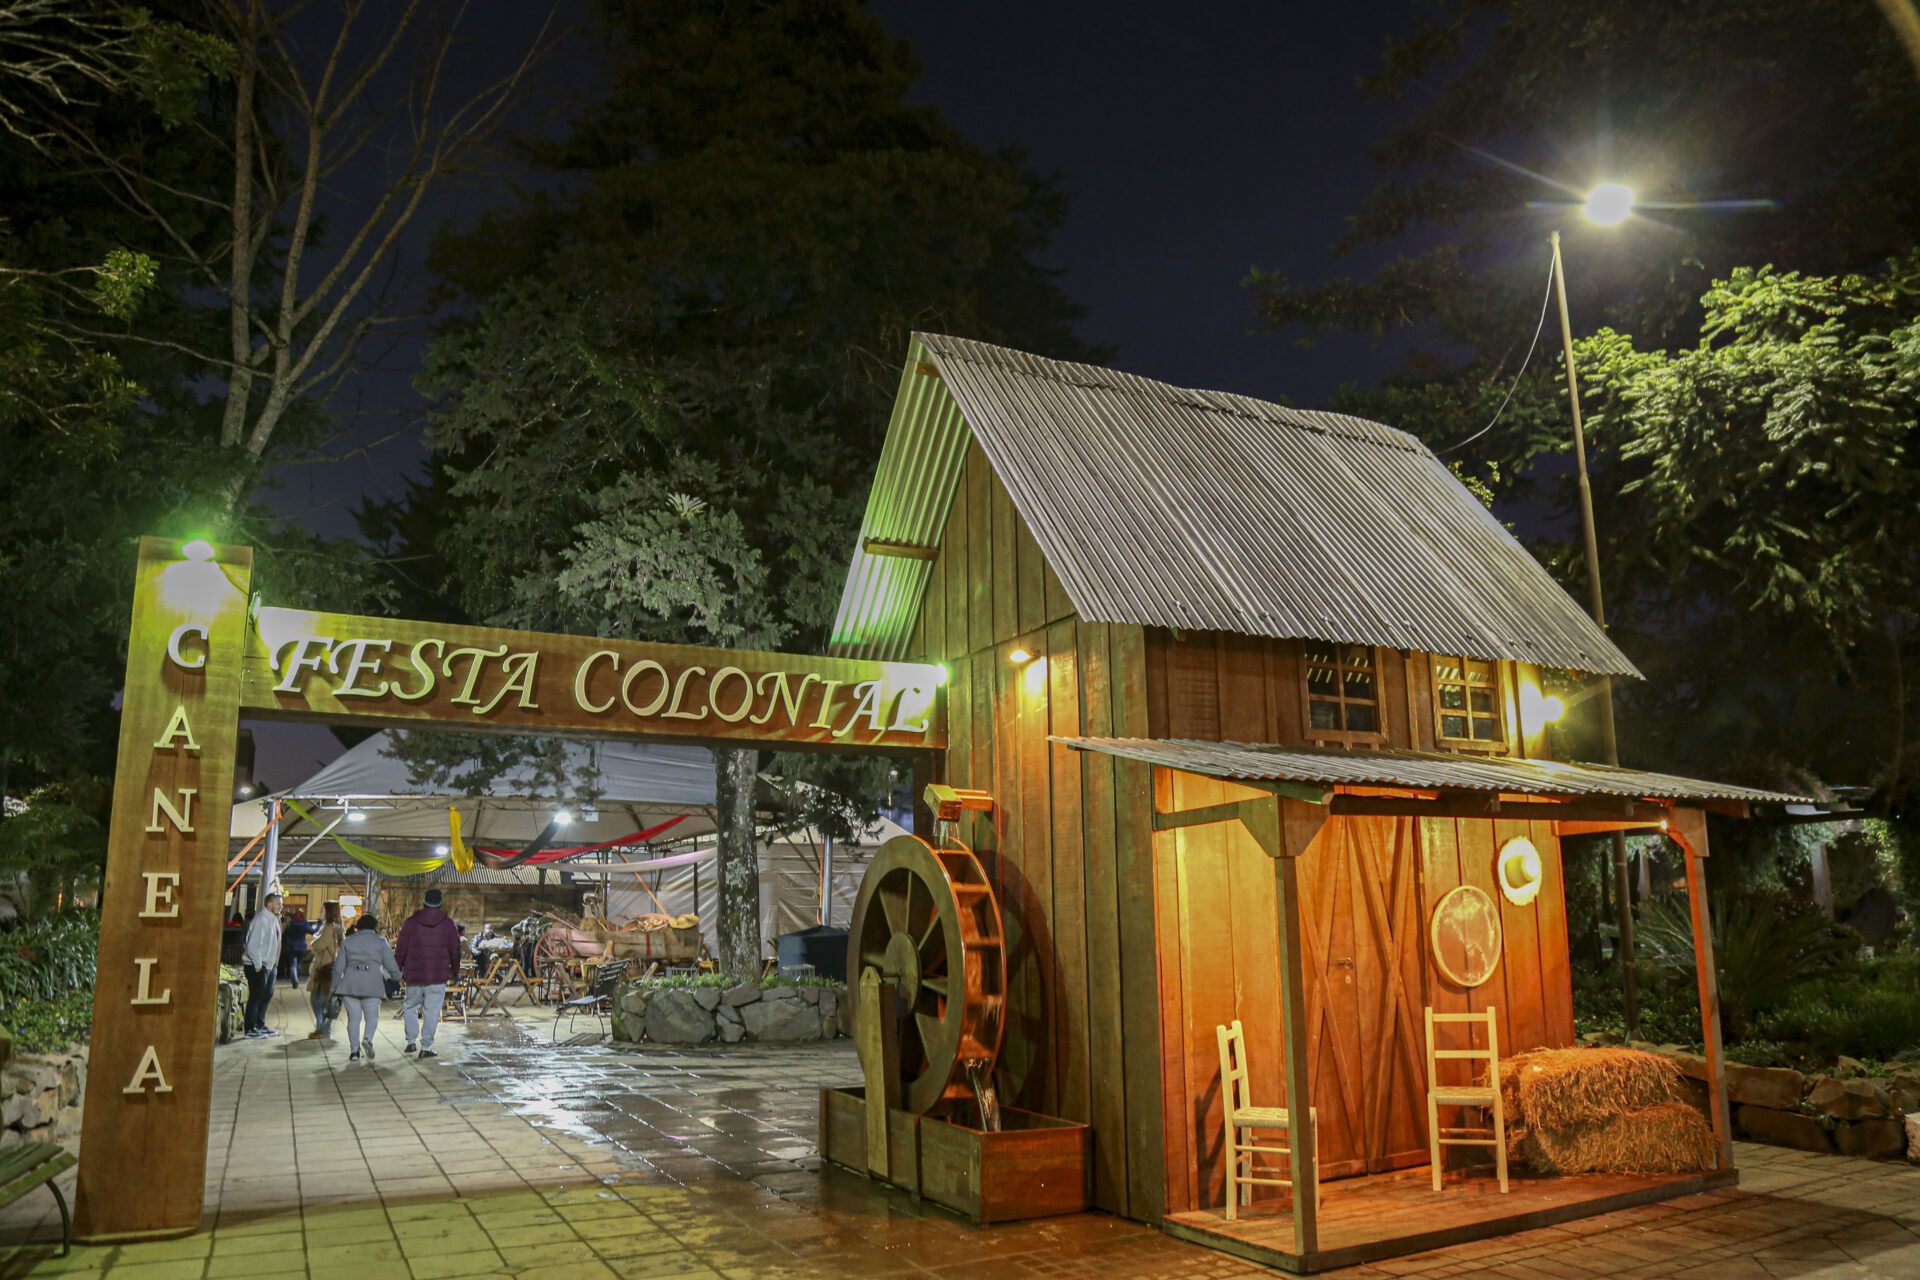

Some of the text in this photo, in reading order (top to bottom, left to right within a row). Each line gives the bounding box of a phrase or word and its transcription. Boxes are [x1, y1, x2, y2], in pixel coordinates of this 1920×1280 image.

[270, 636, 929, 737] FESTA COLONIAL
[123, 624, 208, 1094] CANELA
